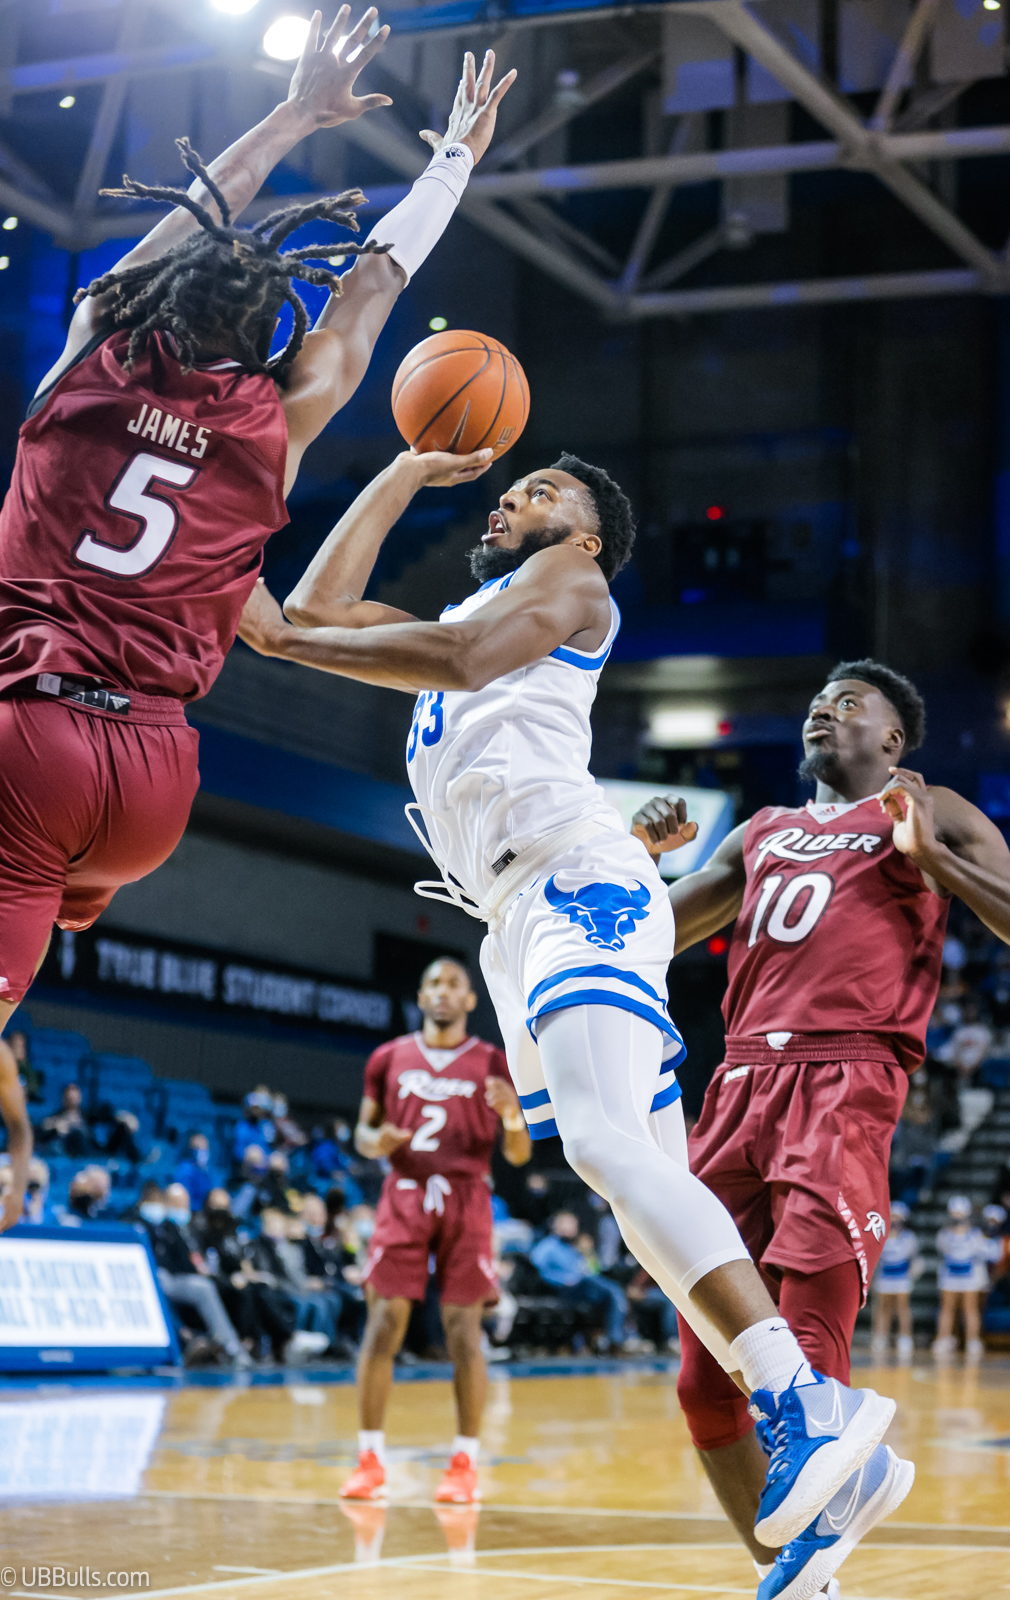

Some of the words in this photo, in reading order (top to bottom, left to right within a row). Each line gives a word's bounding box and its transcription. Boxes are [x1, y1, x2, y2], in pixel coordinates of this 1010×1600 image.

[126, 403, 212, 459] JAMES
[73, 451, 200, 579] 5
[753, 826, 882, 872] RIDER
[747, 872, 834, 948] 10
[410, 1104, 447, 1152] 2
